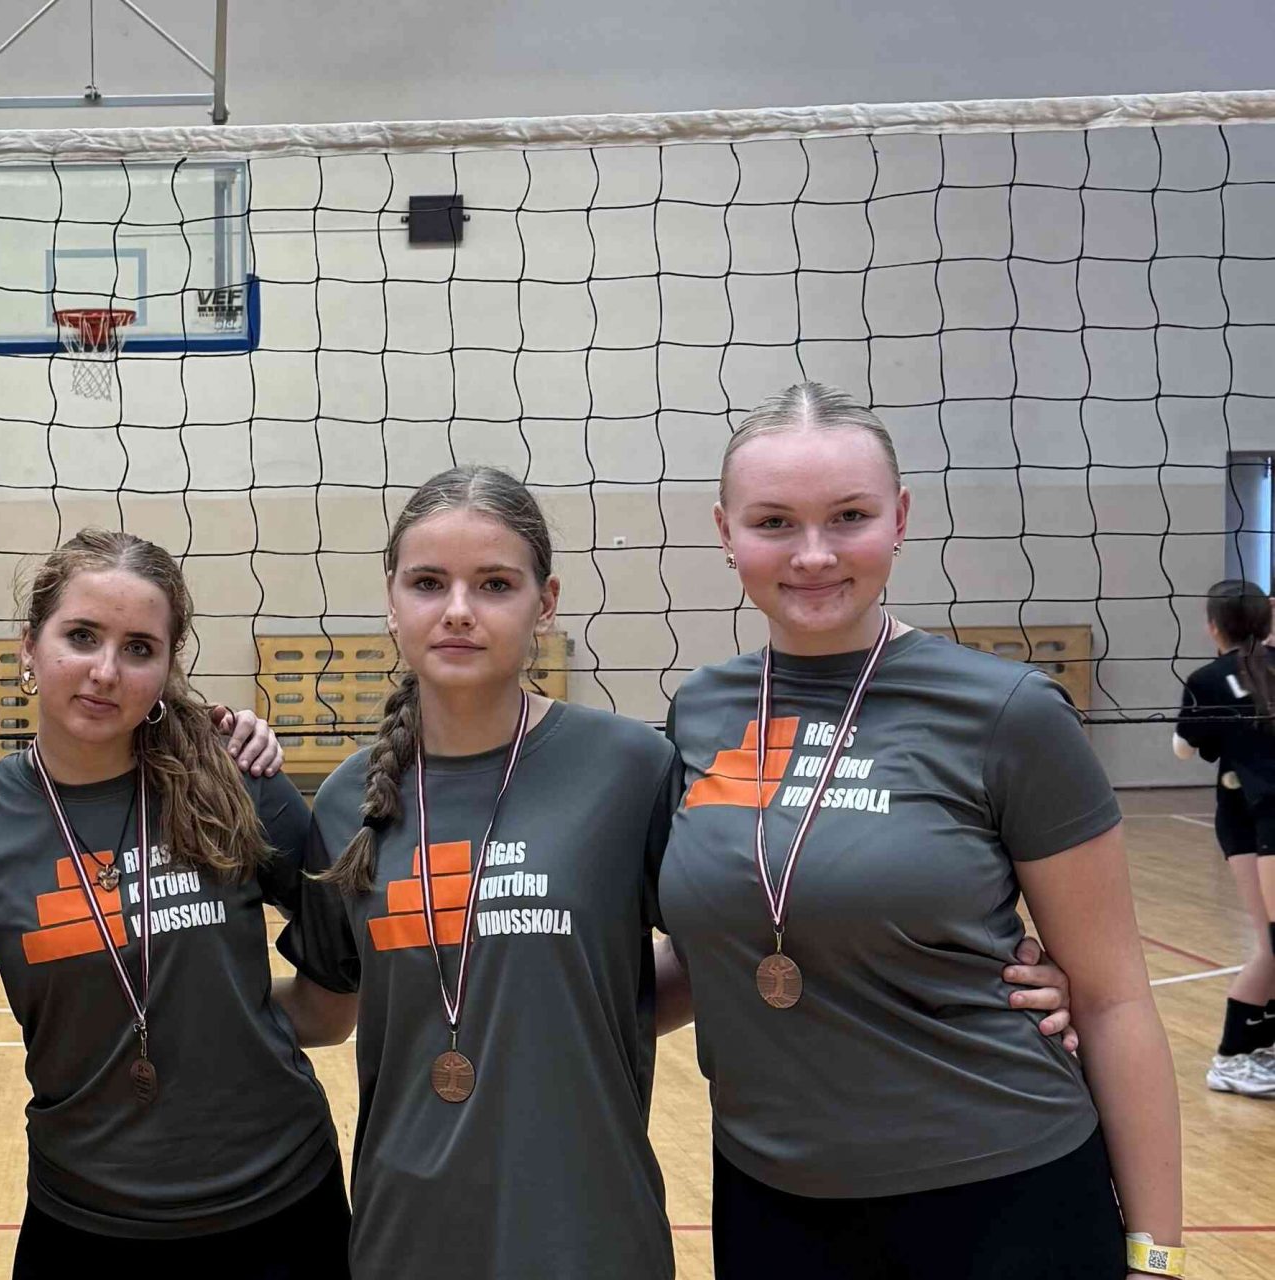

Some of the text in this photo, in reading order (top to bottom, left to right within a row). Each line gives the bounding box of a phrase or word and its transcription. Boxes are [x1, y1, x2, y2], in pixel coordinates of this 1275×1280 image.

[197, 289, 243, 305] VEF
[803, 721, 858, 748] RĪGS
[781, 786, 891, 814] VIDSSKOLA
[123, 844, 172, 874] RĪAS
[128, 871, 200, 904] KLTŪRU
[479, 871, 548, 900] KULTŪRU
[130, 901, 226, 938] VDUSSKOLA
[477, 908, 571, 937] VIDUSSKOLA
